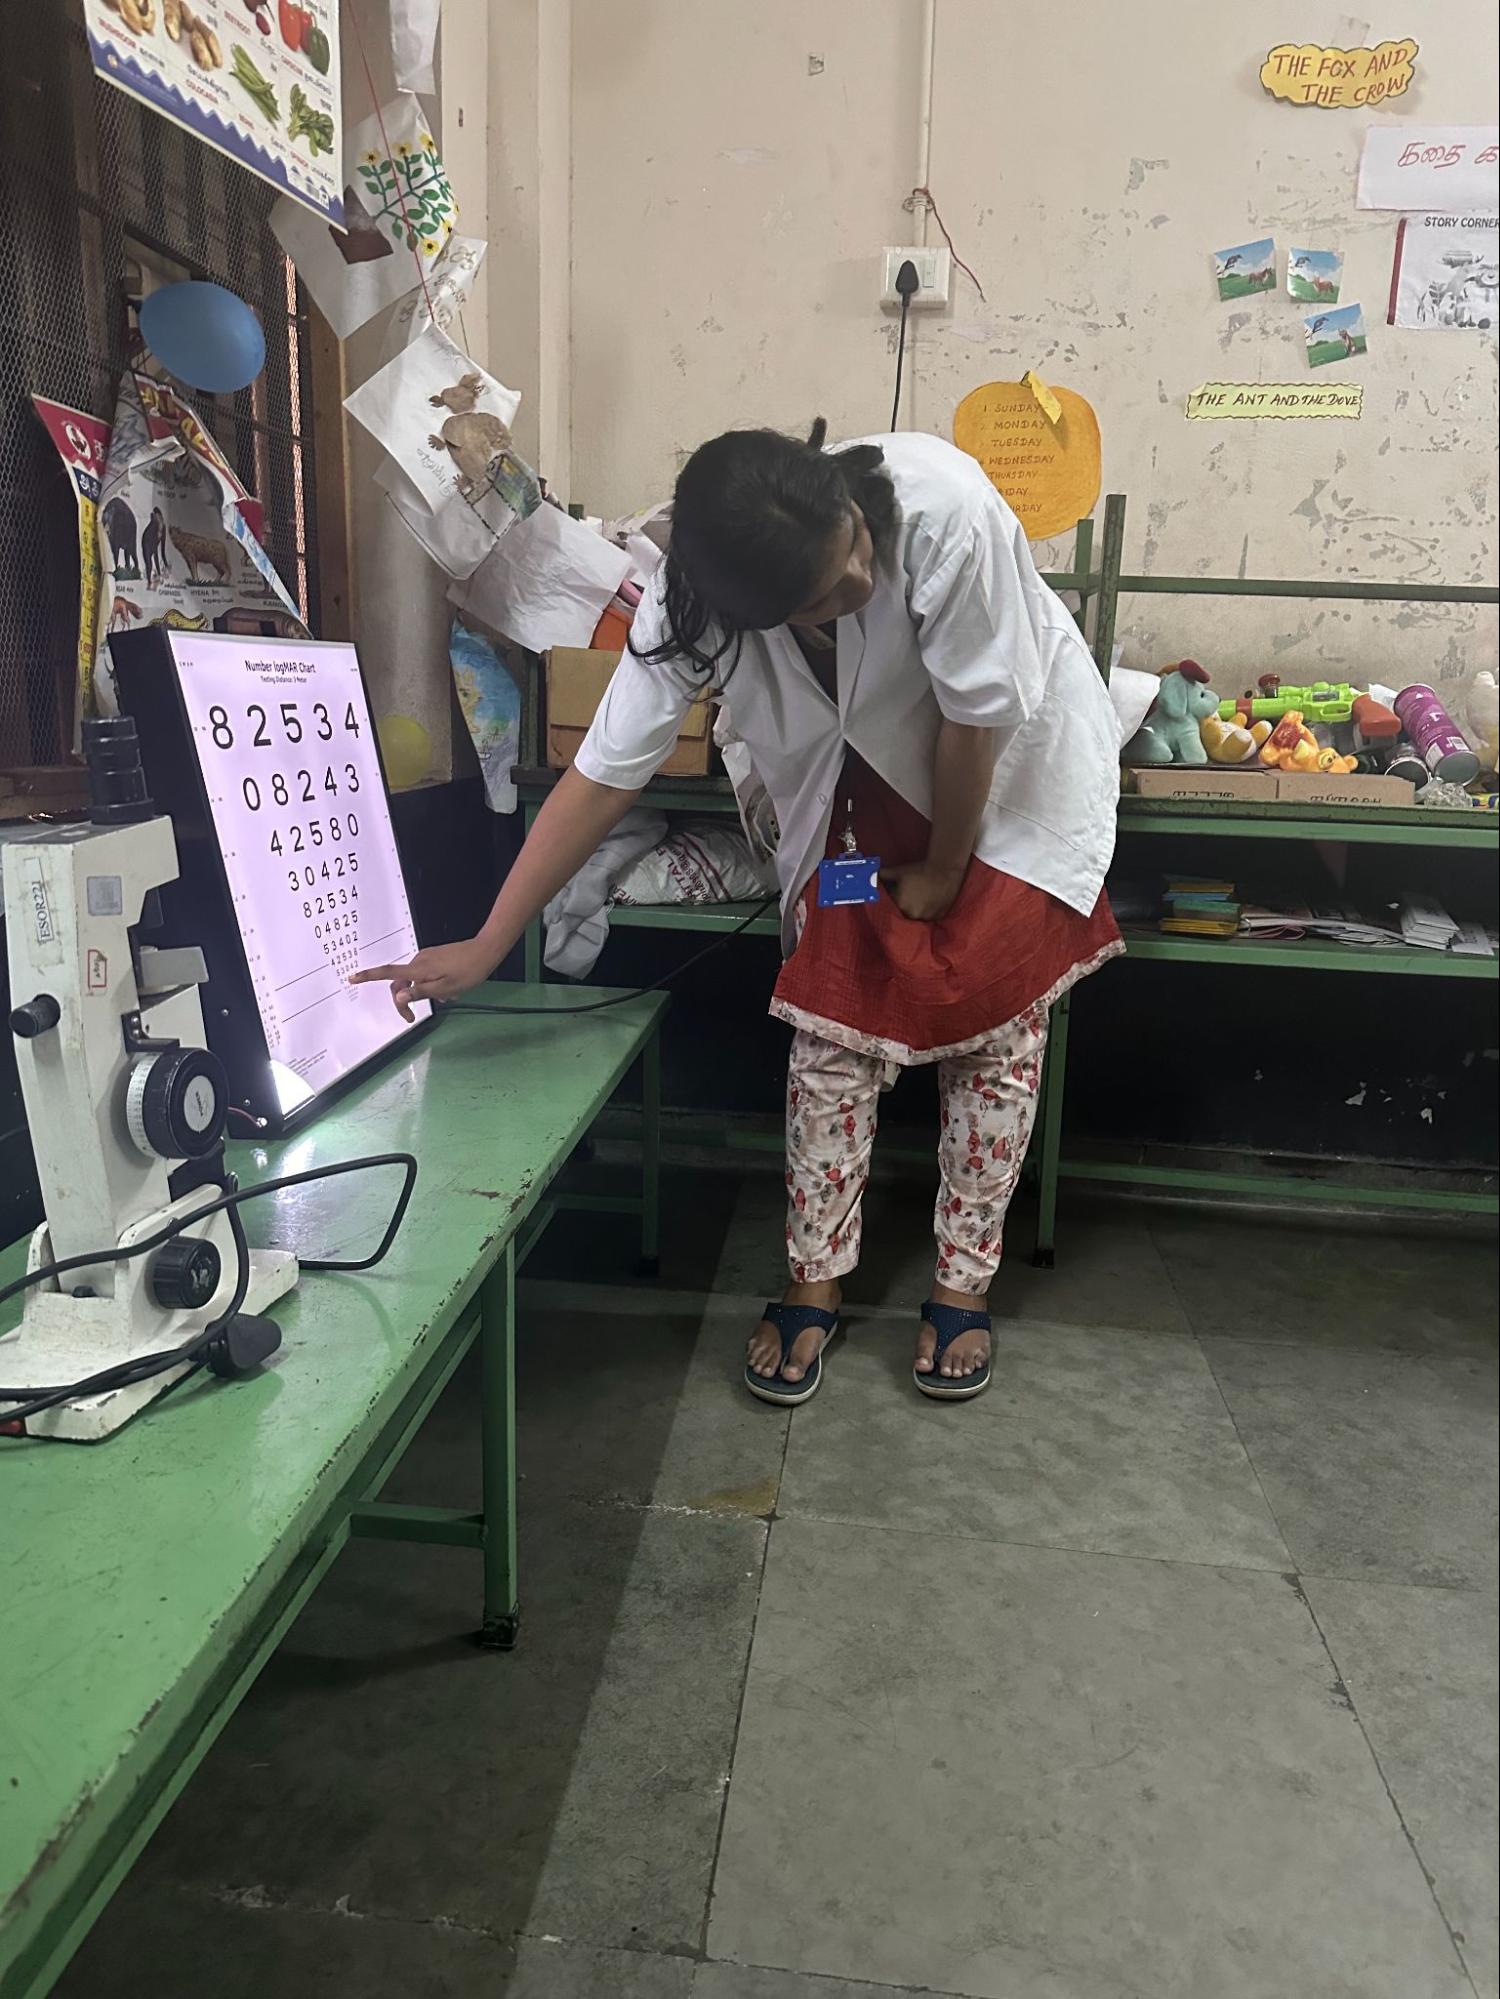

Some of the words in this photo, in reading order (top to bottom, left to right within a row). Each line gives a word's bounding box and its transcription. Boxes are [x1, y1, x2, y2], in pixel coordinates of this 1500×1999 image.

[1274, 54, 1312, 77] THE
[1317, 57, 1356, 78] FOX
[1364, 48, 1408, 78] AND
[1301, 83, 1343, 104] THE
[1354, 73, 1406, 102] CROW
[1424, 216, 1458, 228] STORY
[1197, 392, 1227, 406] THE
[1233, 393, 1268, 405] ANT
[1270, 394, 1300, 406] AND
[1301, 394, 1328, 405] THE
[1326, 394, 1360, 405] DOVE
[994, 403, 1041, 413] SUNDAY
[994, 420, 1047, 430] MONDAY
[991, 438, 1043, 448] TUESDAY
[989, 455, 1055, 465] WEDNESDAY
[988, 471, 1039, 480] THURSDAY
[245, 660, 272, 672] Number
[273, 660, 298, 675] logMAR
[298, 662, 317, 673] Chart
[32, 880, 51, 938] ESOR221
